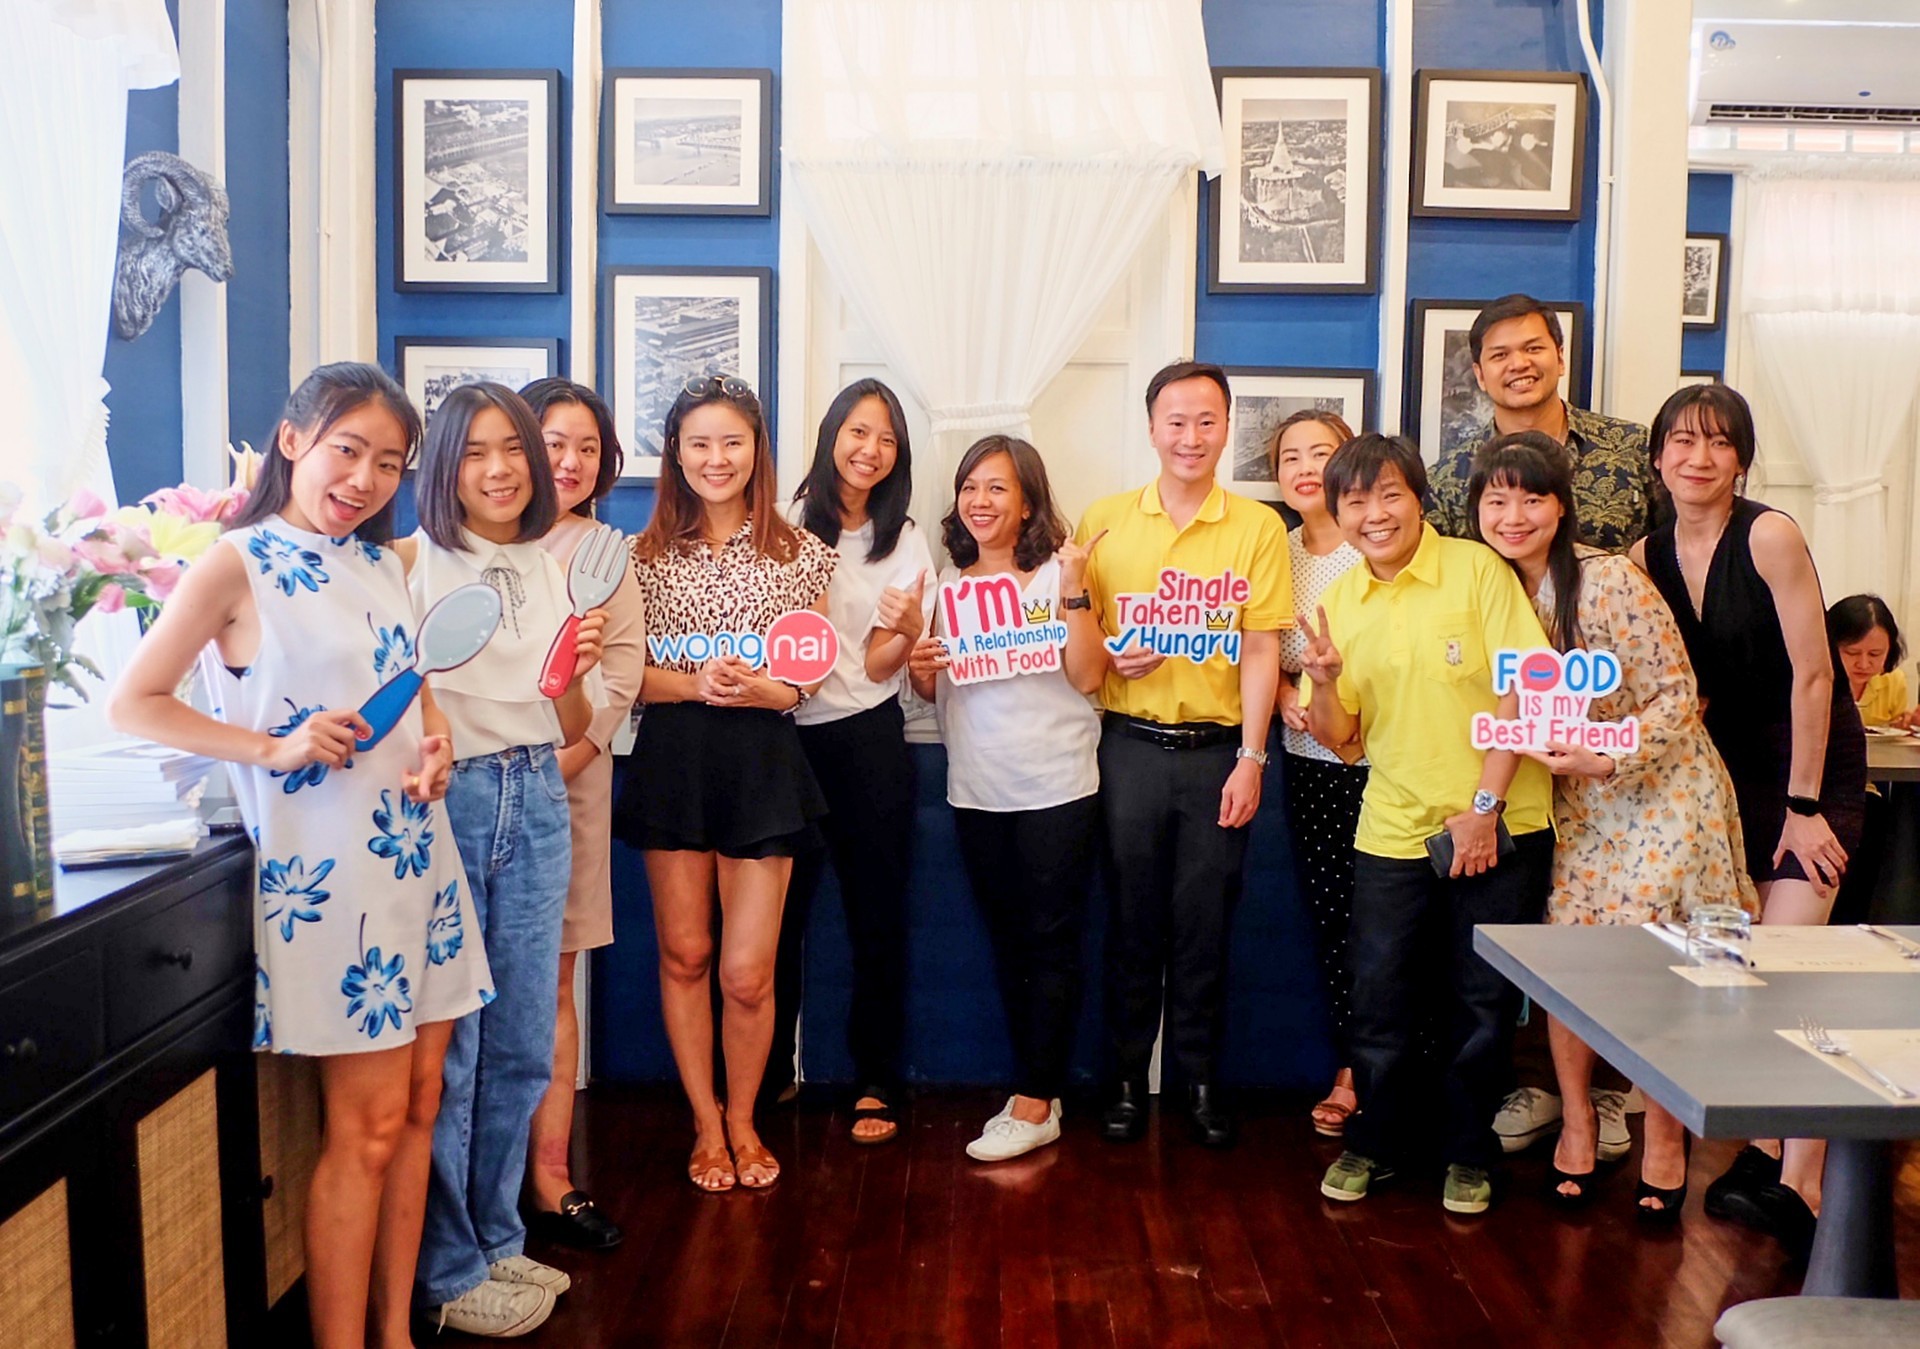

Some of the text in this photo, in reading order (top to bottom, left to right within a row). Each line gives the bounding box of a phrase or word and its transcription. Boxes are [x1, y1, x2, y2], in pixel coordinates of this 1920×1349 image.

[944, 577, 1022, 638] I'm
[1158, 570, 1249, 610] Single
[1116, 597, 1200, 626] Taken
[649, 629, 829, 668] wong nai
[958, 638, 968, 654] A
[973, 624, 1067, 652] Relationship
[1139, 626, 1239, 662] Hungry
[949, 643, 1056, 681] With Food
[1498, 652, 1617, 693] FOOD
[1476, 717, 1634, 749] Best Friend
